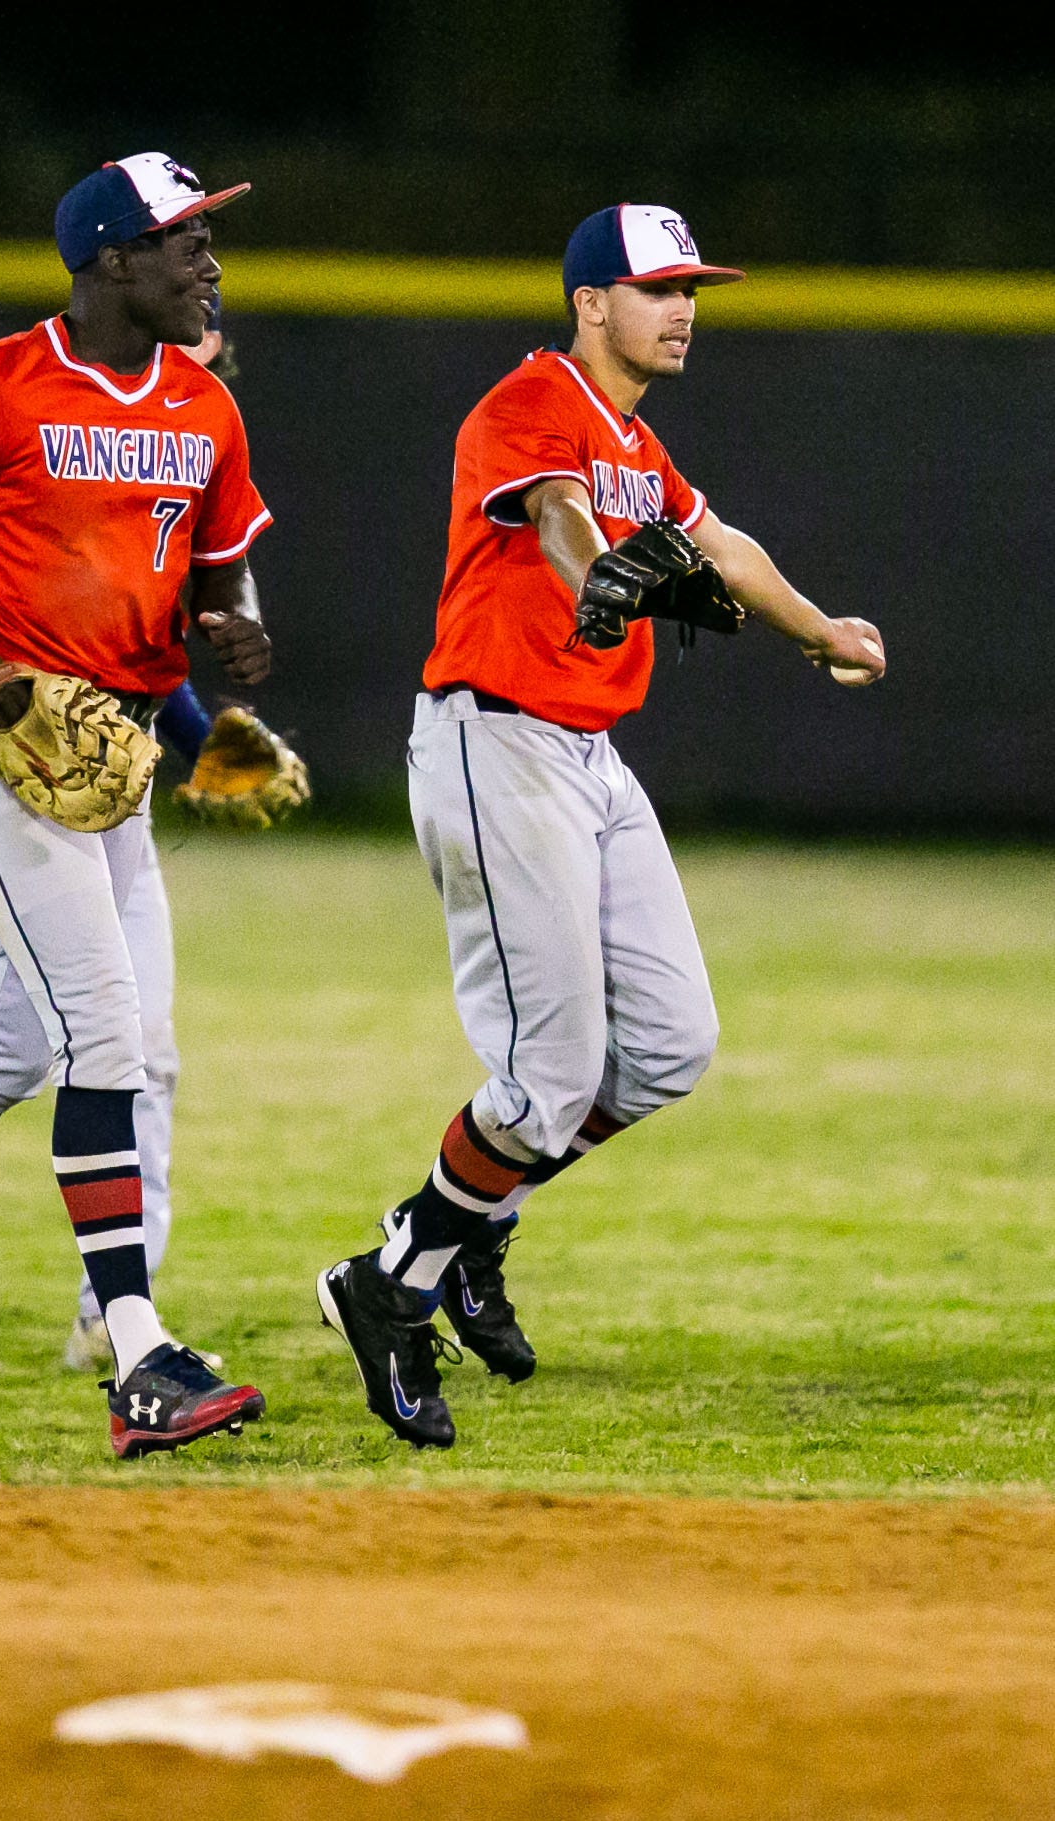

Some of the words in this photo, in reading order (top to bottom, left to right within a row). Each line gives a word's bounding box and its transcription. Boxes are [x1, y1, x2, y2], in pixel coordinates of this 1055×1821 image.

[660, 219, 696, 256] V
[38, 424, 215, 490] VANGUARD
[151, 497, 191, 572] 7
